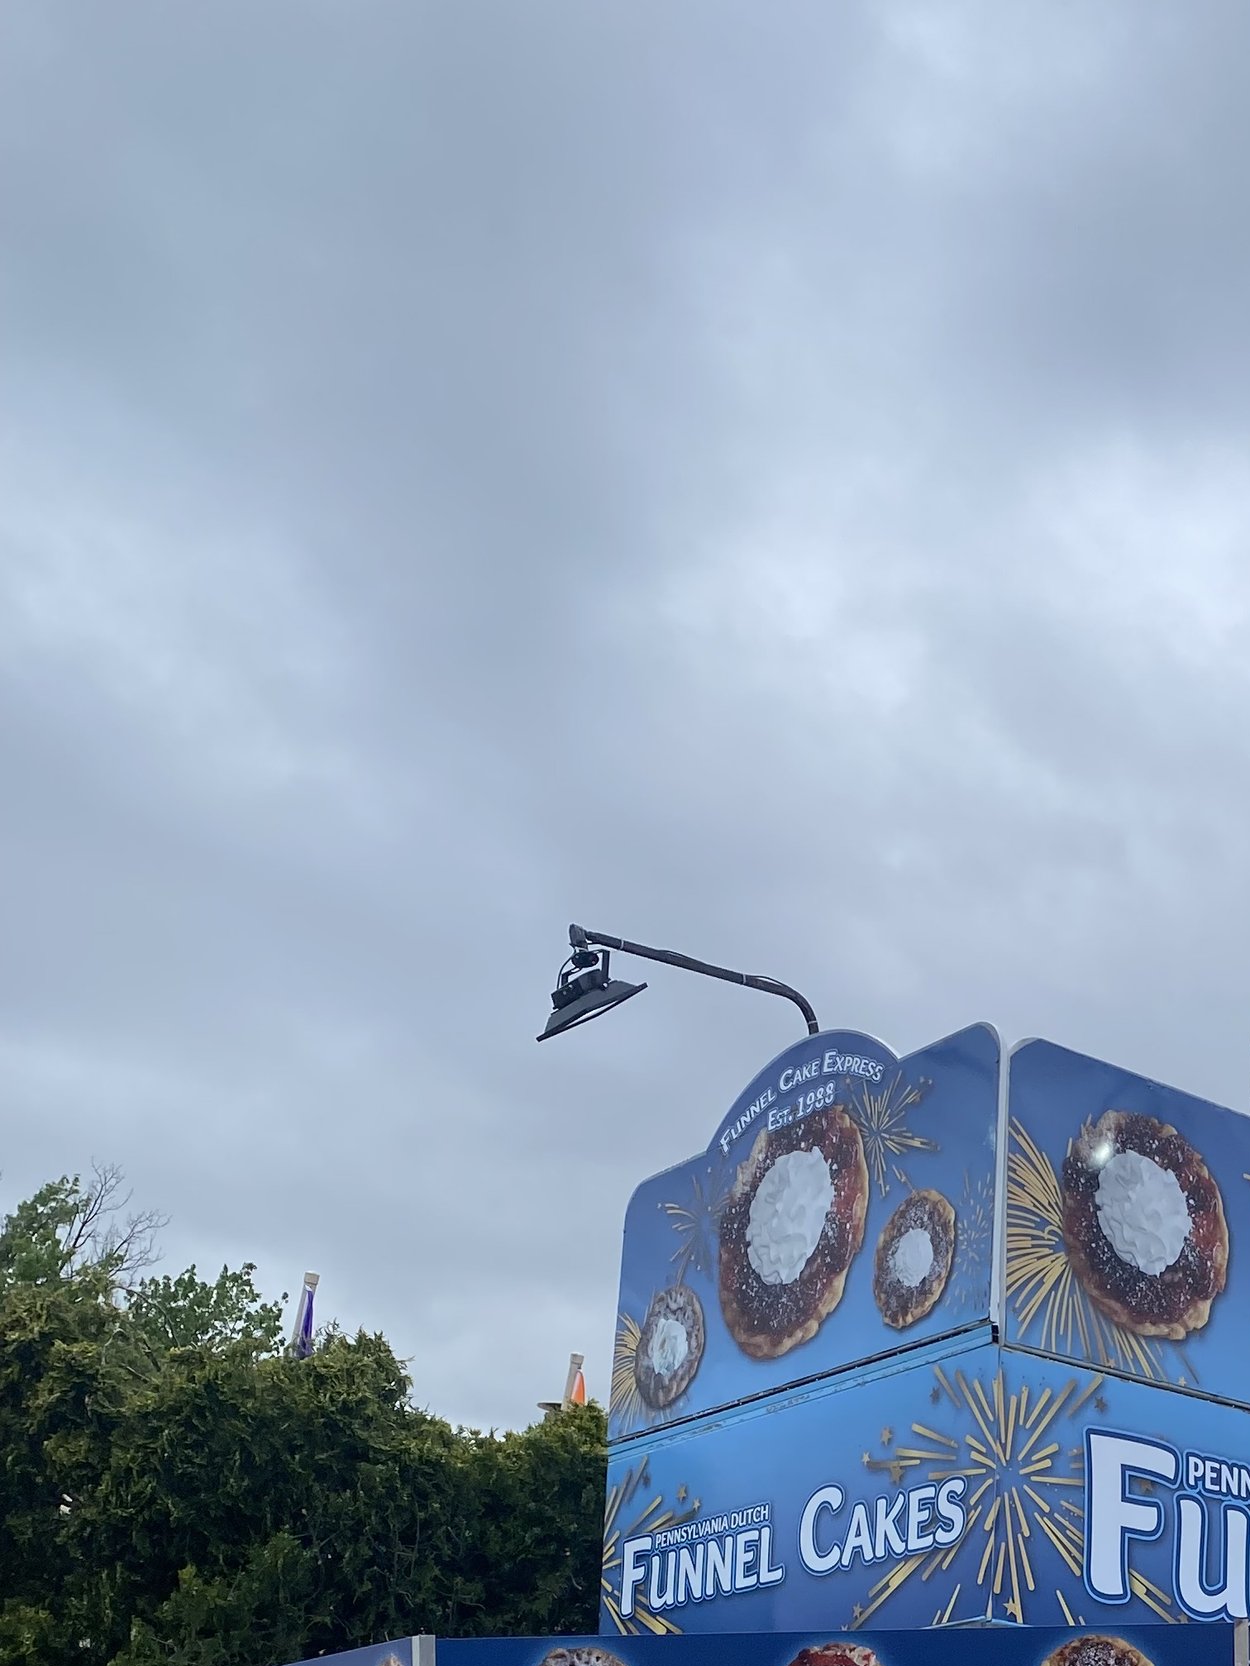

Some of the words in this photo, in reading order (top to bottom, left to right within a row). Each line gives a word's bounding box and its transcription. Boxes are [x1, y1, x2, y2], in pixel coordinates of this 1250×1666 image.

[719, 1089, 777, 1153] FUNNEL
[779, 1060, 821, 1092] CAKE
[823, 1050, 885, 1082] EXPRESS
[797, 1081, 835, 1118] 1988
[620, 1526, 784, 1618] FUNNEL
[799, 1476, 966, 1576] CAKES
[655, 1516, 729, 1549] PENNSYLVANIA
[730, 1502, 770, 1530] DUTCH
